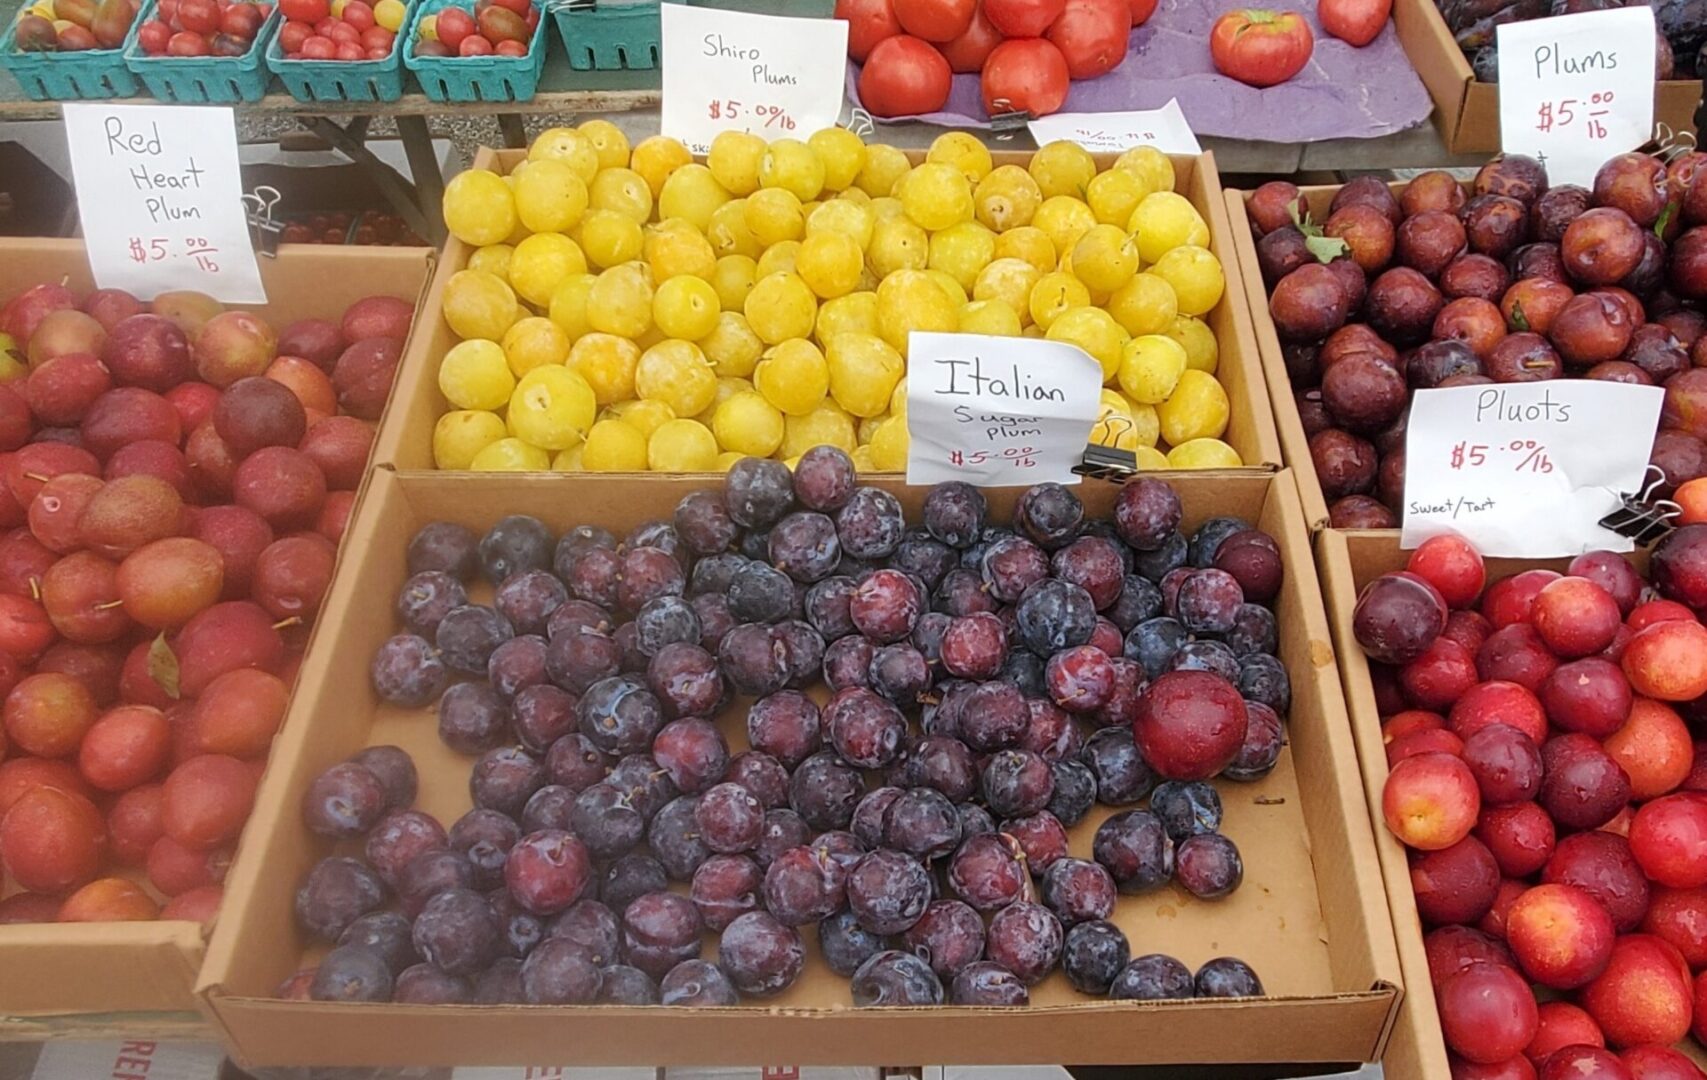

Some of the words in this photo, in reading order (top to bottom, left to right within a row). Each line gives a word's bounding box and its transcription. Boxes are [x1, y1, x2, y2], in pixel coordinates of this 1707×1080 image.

[703, 33, 760, 61] Shiro
[1535, 42, 1617, 79] Plums
[752, 64, 797, 86] Plums
[104, 116, 162, 155] Red
[129, 156, 205, 190] Heart
[145, 195, 201, 223] Plum
[934, 356, 1065, 402] Italian
[953, 405, 1045, 428] Sugar
[1476, 388, 1572, 423] Pluots
